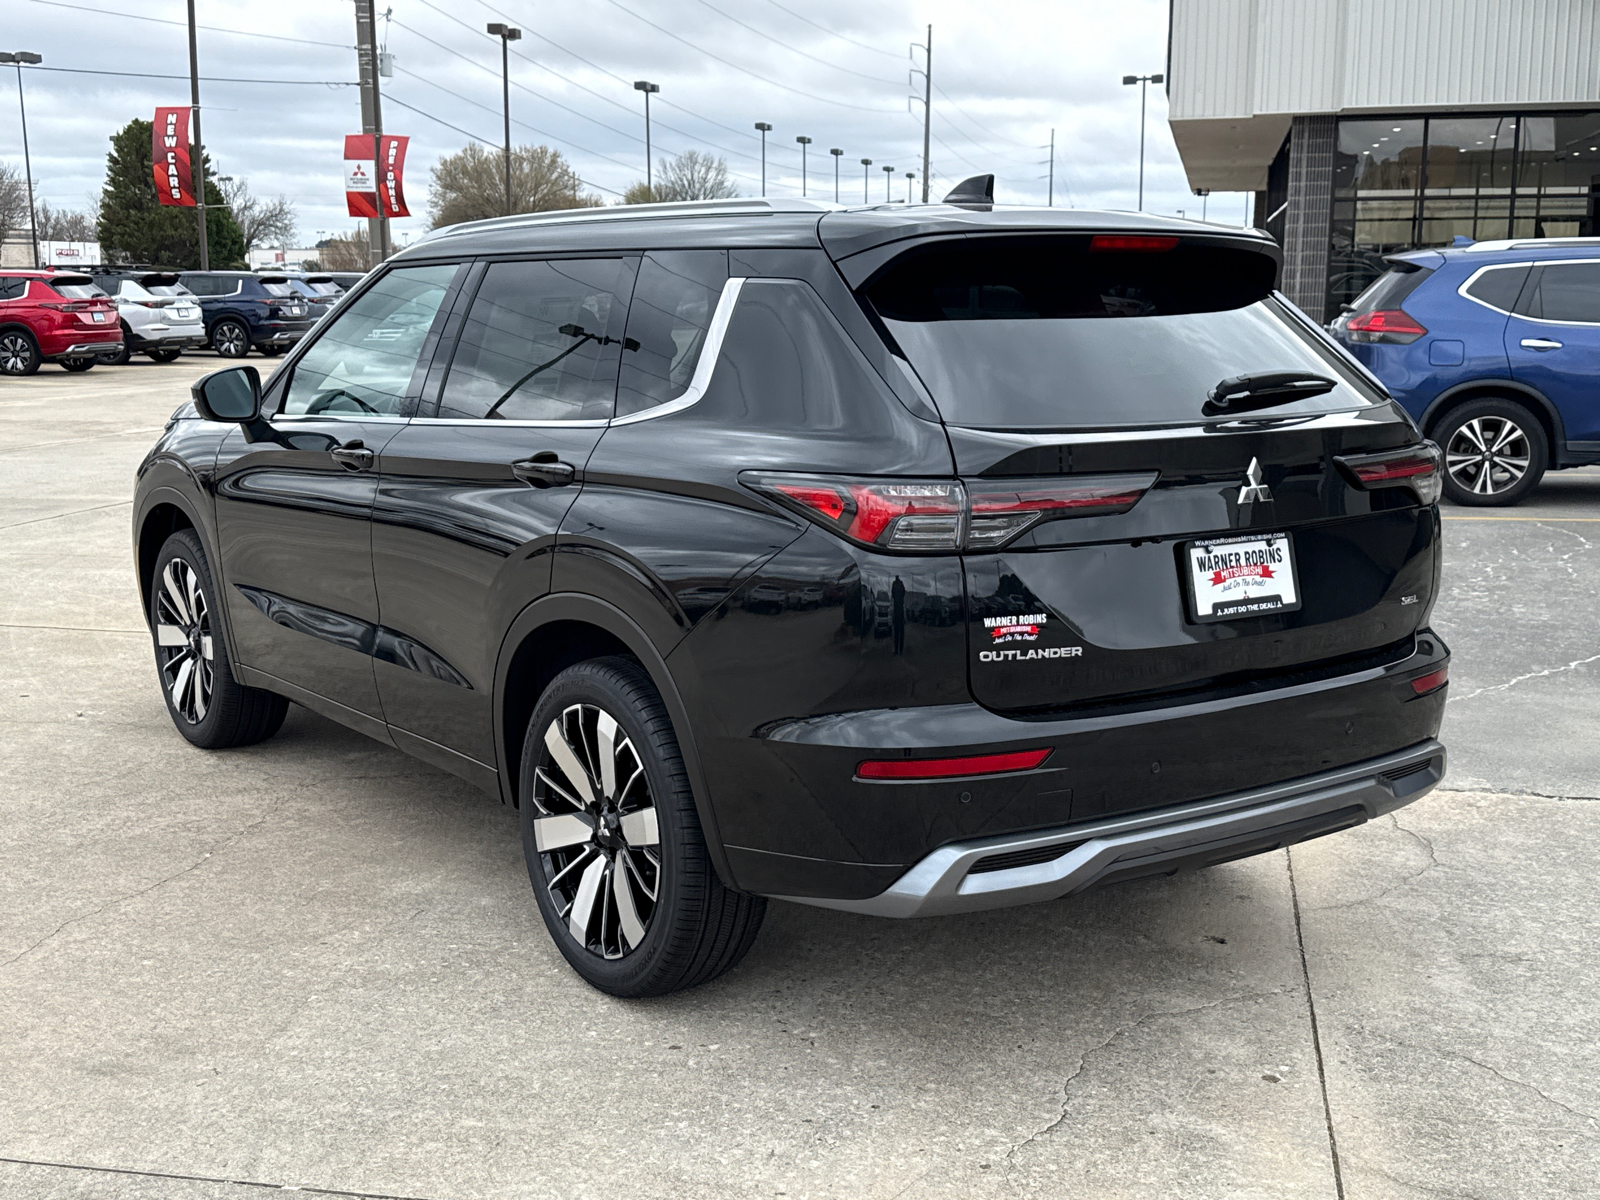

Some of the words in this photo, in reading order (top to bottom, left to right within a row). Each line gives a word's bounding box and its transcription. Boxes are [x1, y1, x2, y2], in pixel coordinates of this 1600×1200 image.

[164, 113, 177, 148] NEW
[167, 152, 181, 199] CARS
[386, 140, 400, 212] PRE-OWNED
[1196, 552, 1240, 572] WARNER
[1244, 547, 1282, 566] ROBINS
[1220, 566, 1263, 580] MITSUBISHI
[1221, 581, 1232, 592] Just
[1242, 578, 1250, 587] The
[1223, 606, 1238, 615] JUST
[1238, 605, 1247, 613] DO
[1247, 604, 1259, 612] THE
[1259, 601, 1276, 610] DEAL!
[984, 616, 1017, 628] WARNER
[1019, 613, 1047, 625] ROBINS
[1000, 626, 1032, 634] MITSUBISHI
[979, 646, 1083, 662] OUTLANDER
